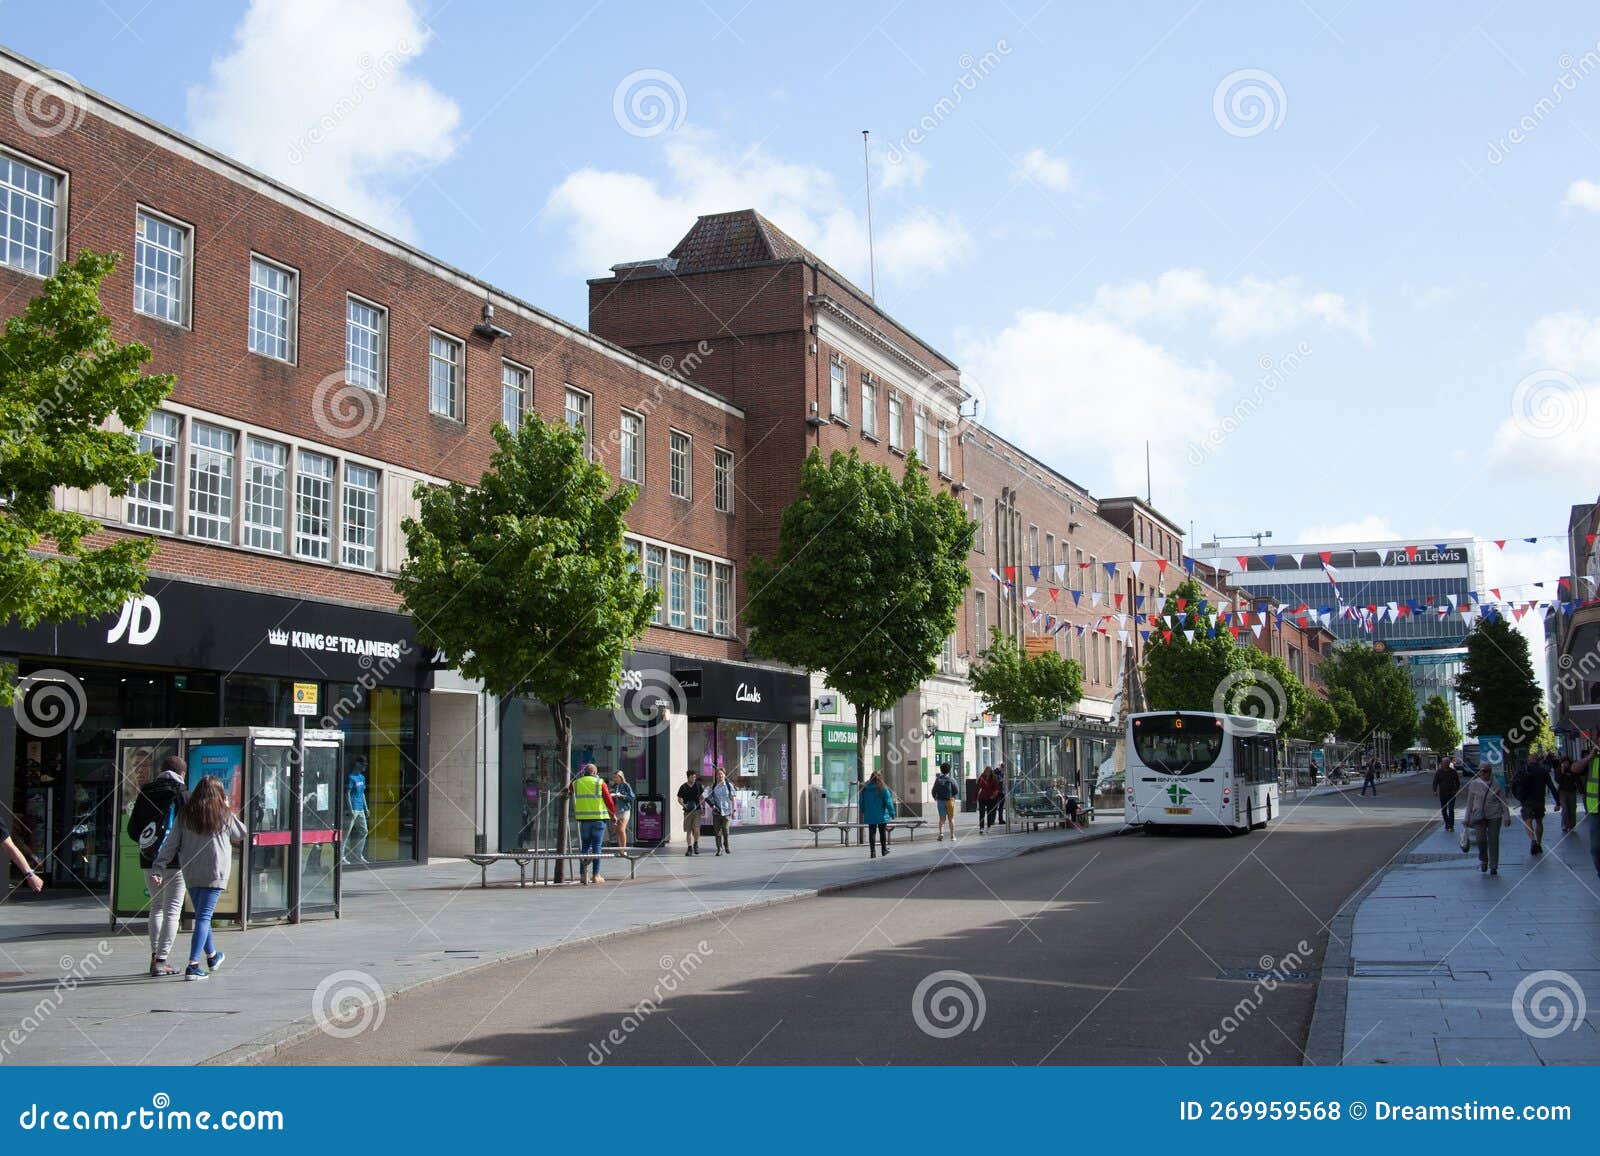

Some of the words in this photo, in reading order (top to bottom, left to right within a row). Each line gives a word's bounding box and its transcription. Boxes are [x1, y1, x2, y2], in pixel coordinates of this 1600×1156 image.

[1425, 550, 1460, 562] Lewis
[107, 594, 161, 646] JD
[292, 630, 324, 650] KING
[325, 635, 338, 647] OF
[339, 637, 400, 659] TRAINERS
[735, 682, 761, 703] Clarks
[828, 730, 847, 743] LLOYDS
[847, 731, 857, 743] BAN
